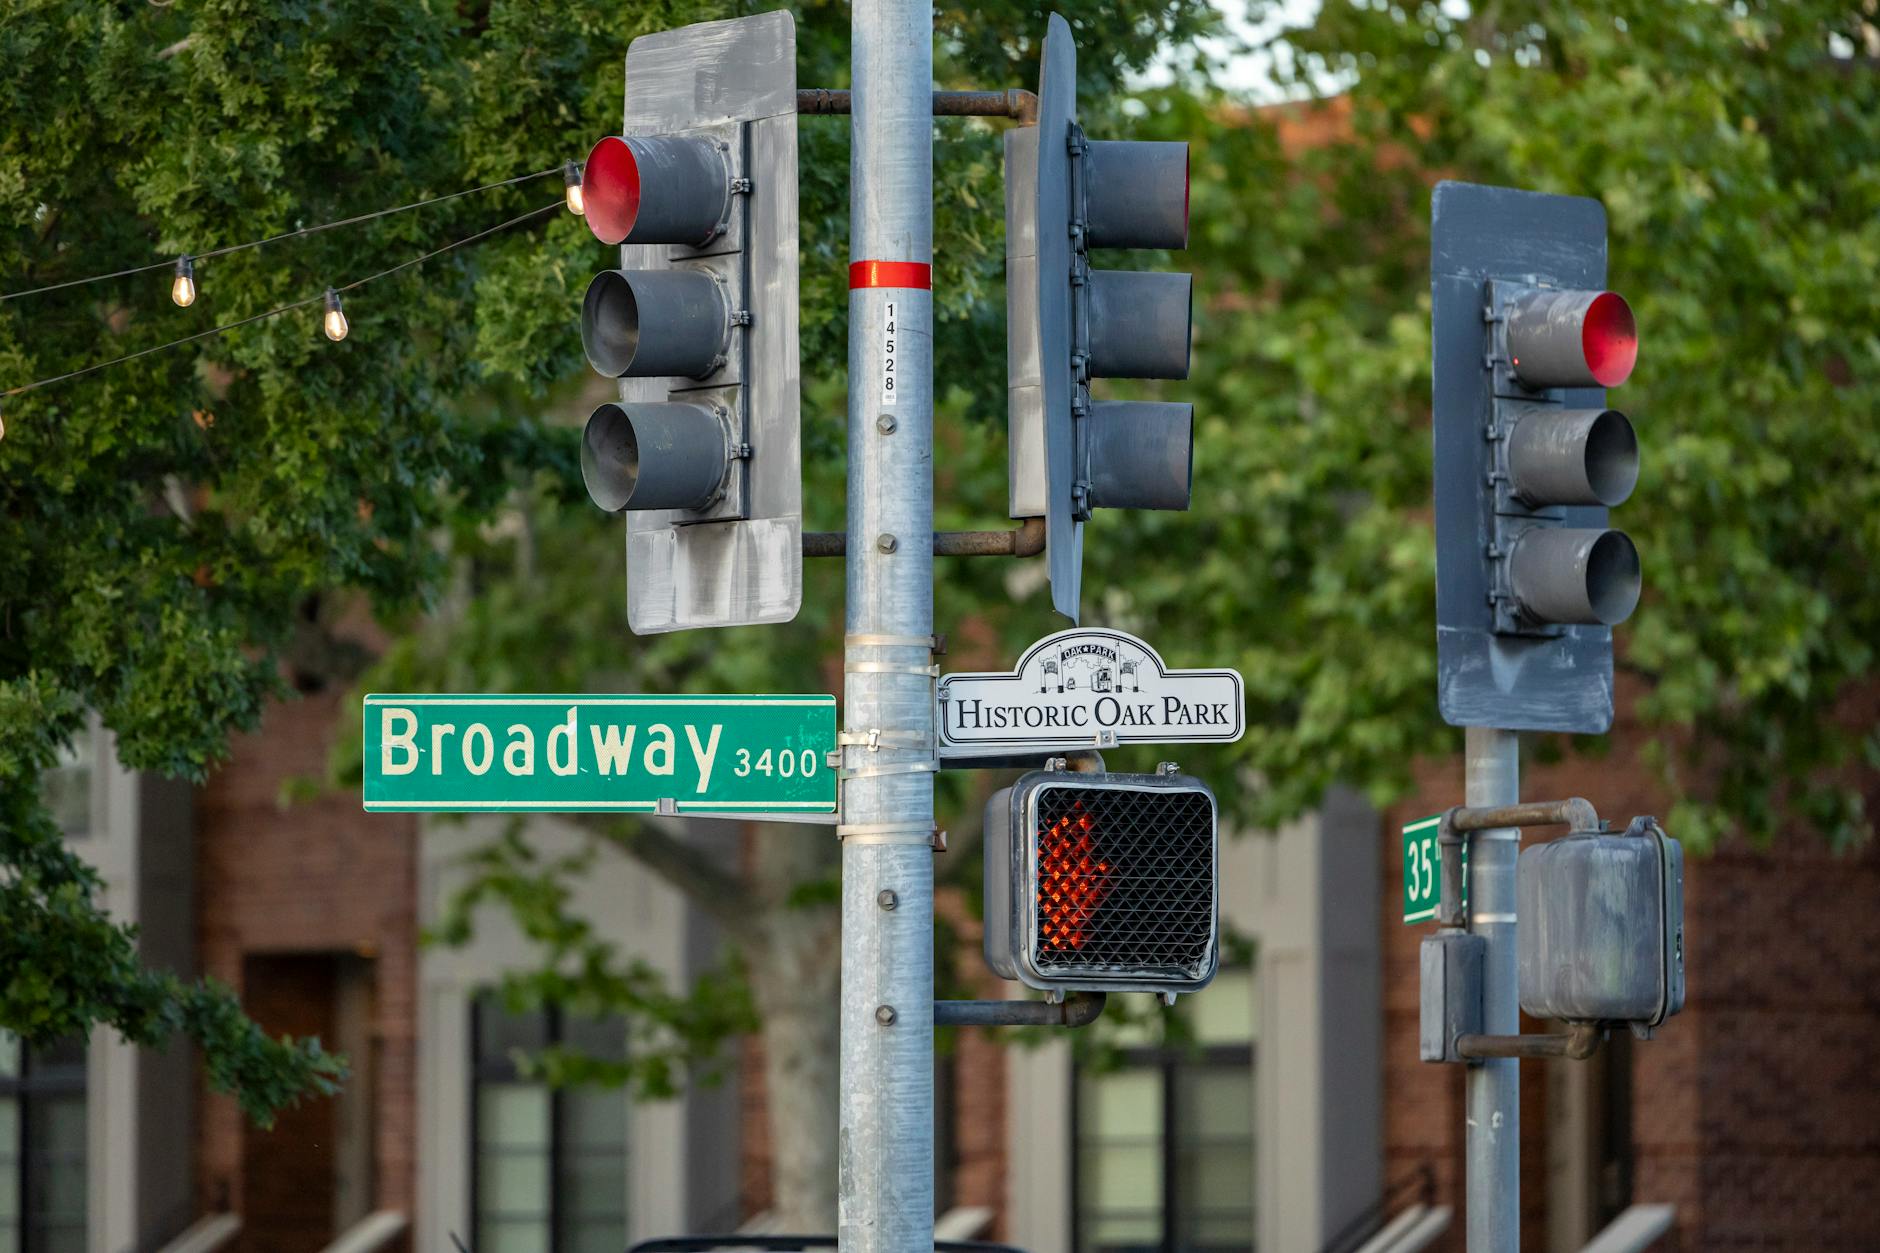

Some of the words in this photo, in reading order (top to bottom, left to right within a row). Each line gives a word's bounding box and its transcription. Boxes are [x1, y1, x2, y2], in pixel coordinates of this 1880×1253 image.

[885, 303, 895, 391] 14528
[1064, 647, 1084, 659] OAK
[1089, 644, 1115, 660] PARK
[956, 698, 1089, 729] HISTORIC
[1094, 696, 1156, 727] OAK
[1161, 696, 1230, 727] PARK
[380, 706, 723, 794] Broadway
[733, 748, 818, 778] 3400
